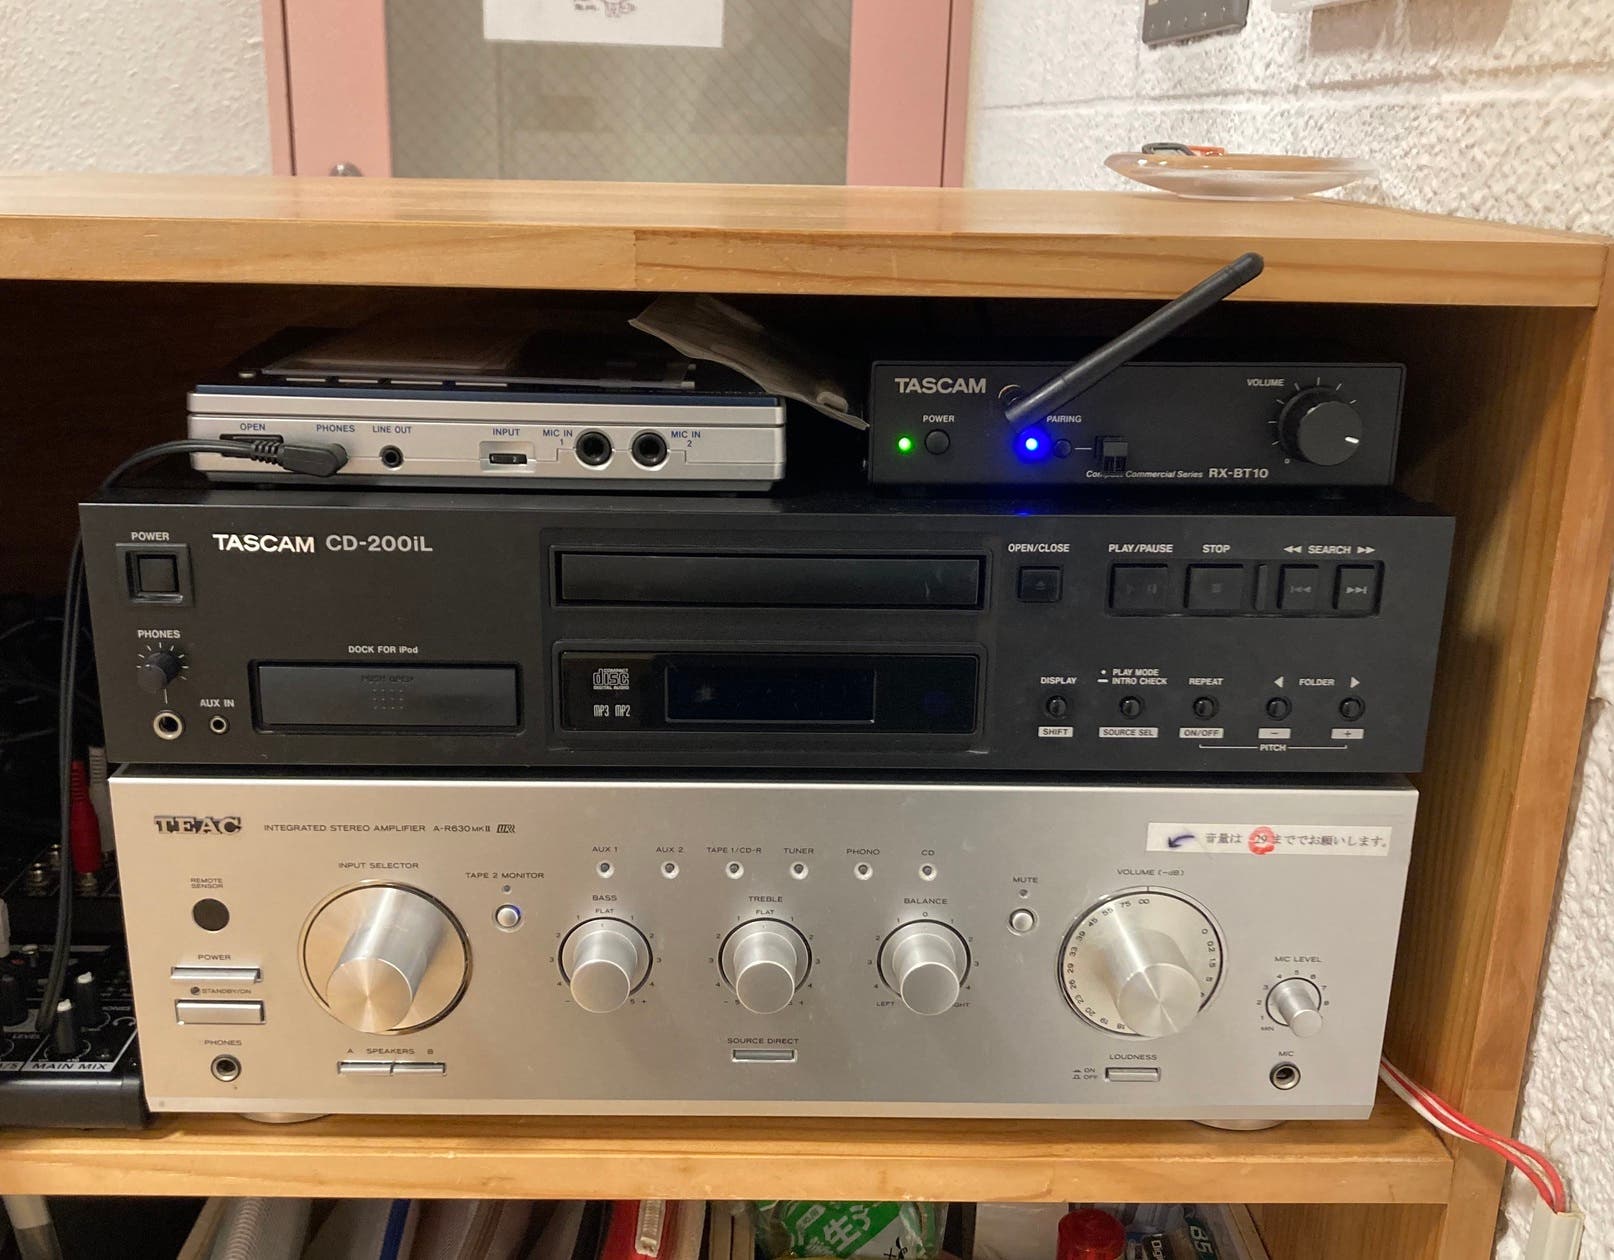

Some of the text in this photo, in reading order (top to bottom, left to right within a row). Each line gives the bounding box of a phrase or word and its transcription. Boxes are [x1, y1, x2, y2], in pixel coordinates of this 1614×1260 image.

[894, 378, 986, 394] TASCAM
[1246, 378, 1285, 387] VOLUME
[922, 415, 955, 423] POWER
[1046, 415, 1082, 423] PAIRING
[240, 423, 266, 432] OPEN
[316, 424, 356, 433] PHONES
[372, 425, 412, 434] LINE OUT
[492, 428, 520, 436] INPUT
[542, 429, 573, 438] MIC IN
[671, 430, 701, 439] MIC IN
[687, 440, 692, 448] 2
[1126, 470, 1176, 478] Commercial
[1177, 470, 1204, 478] Series
[1208, 468, 1268, 479] RX-BT10
[131, 532, 170, 541] POWER
[212, 534, 433, 552] TASCAM CD-200iL
[1008, 544, 1070, 553] OPEN/CLOSE
[1108, 544, 1173, 554] PLAY/PAUSE
[1202, 544, 1230, 554] STOP
[1308, 546, 1352, 555] SEARCH
[138, 630, 180, 639] PHONES
[348, 646, 418, 654] DOCK FOR iPod
[1112, 668, 1159, 676] PLAY MODE
[1040, 676, 1076, 685] DISPLAY
[1112, 677, 1168, 686] INTRO CHECK
[1188, 678, 1224, 686] REPEAT
[1298, 678, 1335, 686] FOLDER
[200, 699, 234, 708] AUX IN
[594, 704, 630, 717] MP3 MP2
[1042, 728, 1068, 736] SHIFT
[1103, 728, 1153, 737] SOURCE SEL
[1184, 728, 1218, 738] ON/OFF
[1260, 744, 1287, 752] PITCH
[154, 816, 242, 834] TEAC
[264, 824, 328, 832] INTEGRATED
[330, 824, 371, 832] STEREO
[373, 824, 426, 832] AMPLIFIER
[846, 848, 880, 856] PHONO
[369, 862, 419, 870] SELECTOR
[1102, 908, 1114, 916] 55
[1087, 917, 1098, 928] 45
[1076, 930, 1086, 942] 39
[1069, 946, 1078, 958] 33
[1066, 963, 1074, 974] 29
